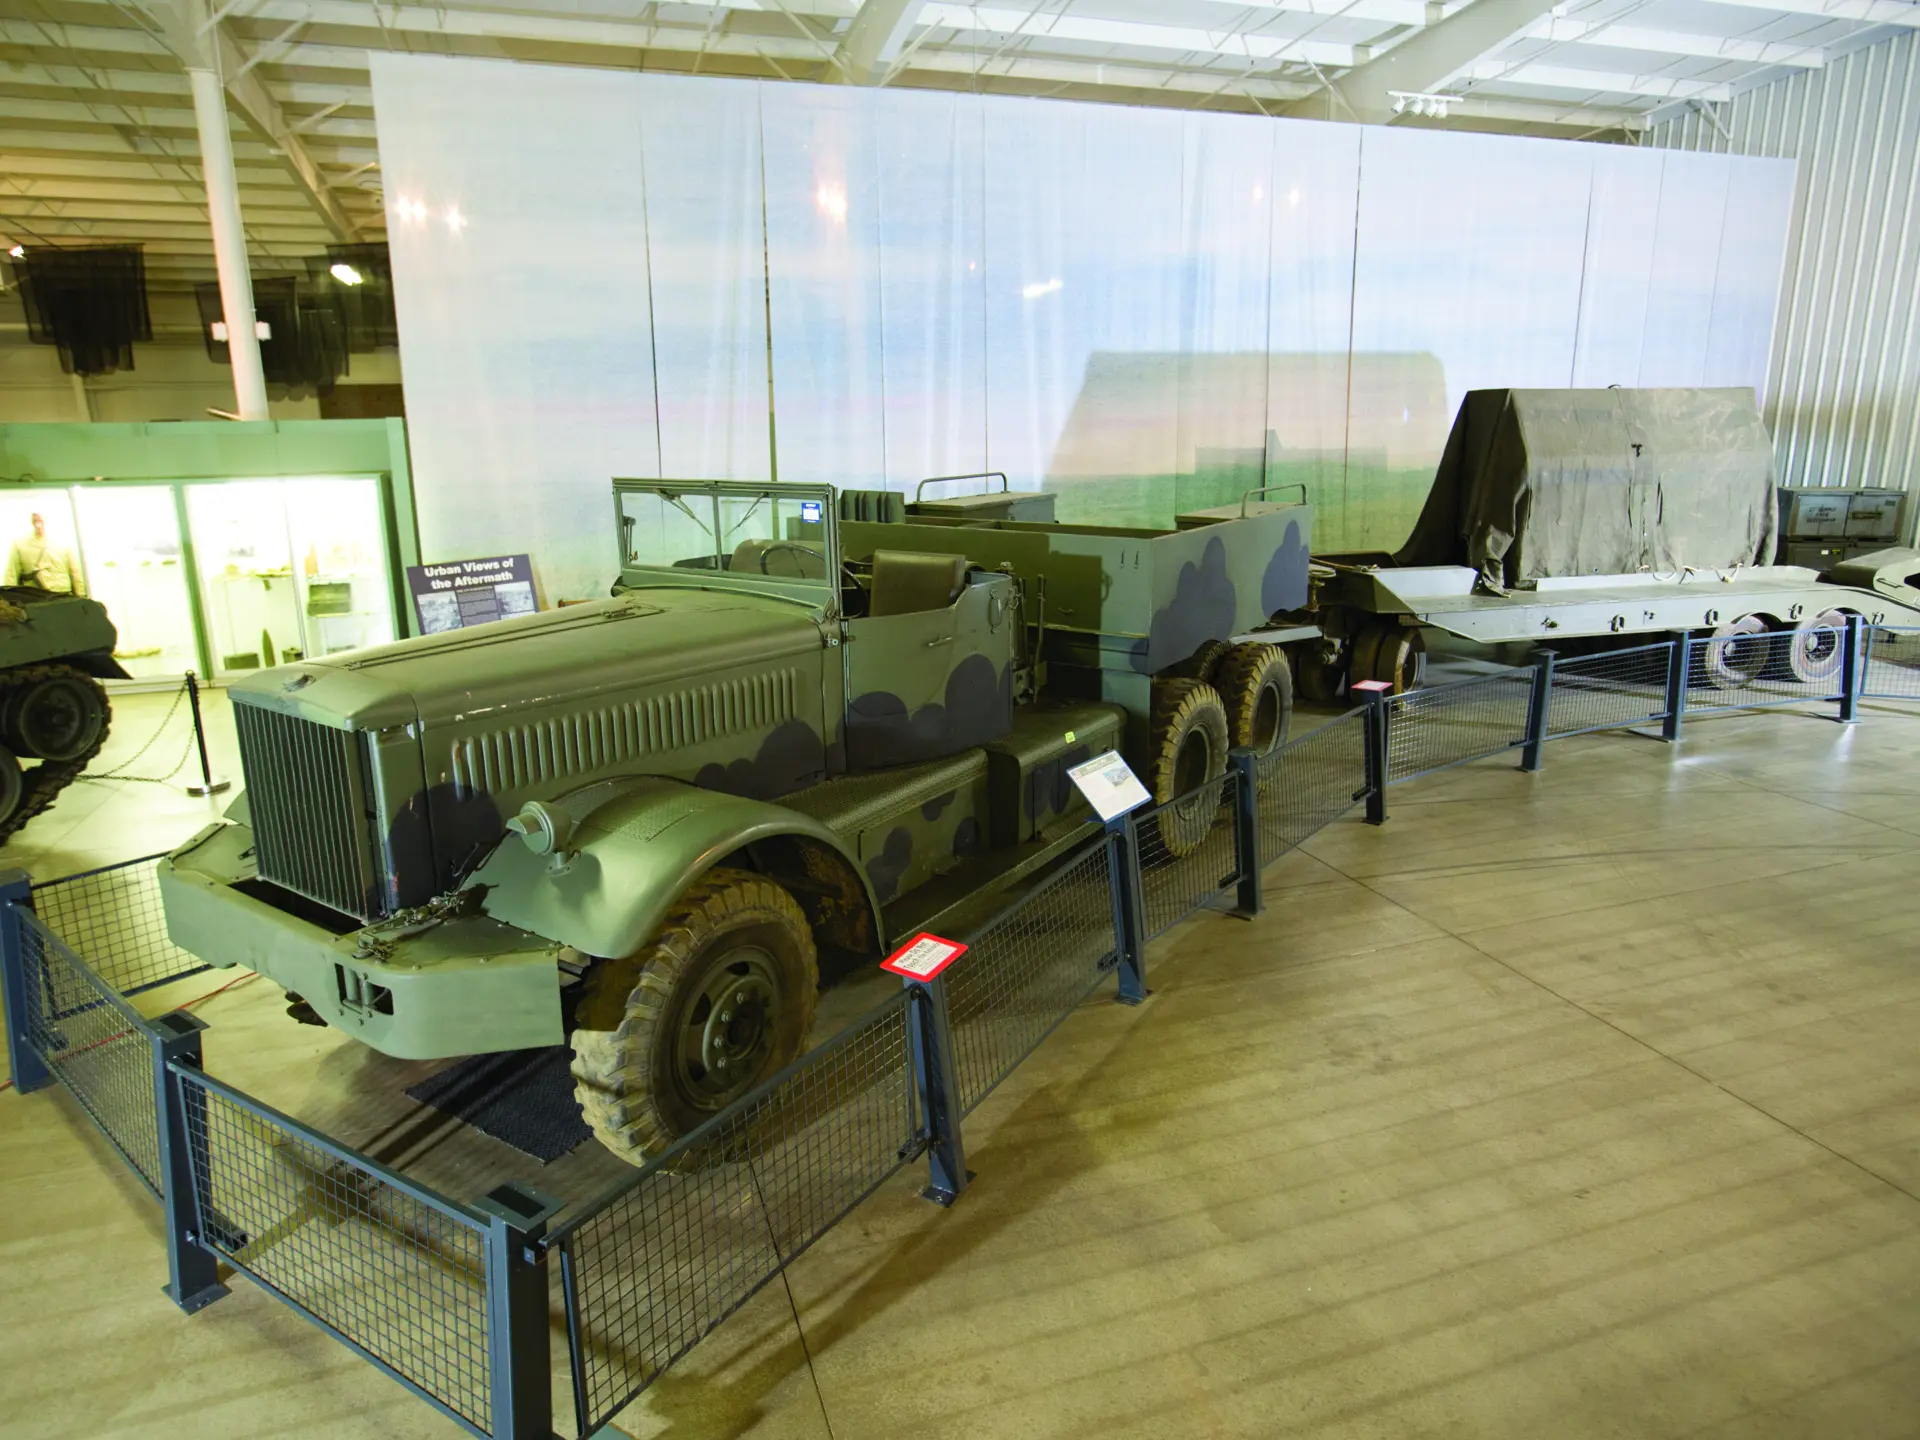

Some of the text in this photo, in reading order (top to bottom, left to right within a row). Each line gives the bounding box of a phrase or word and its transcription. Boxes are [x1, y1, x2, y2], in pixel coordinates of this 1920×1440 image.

[424, 558, 514, 577] Urban Views of
[431, 579, 452, 589] the
[455, 571, 513, 586] Aftermath
